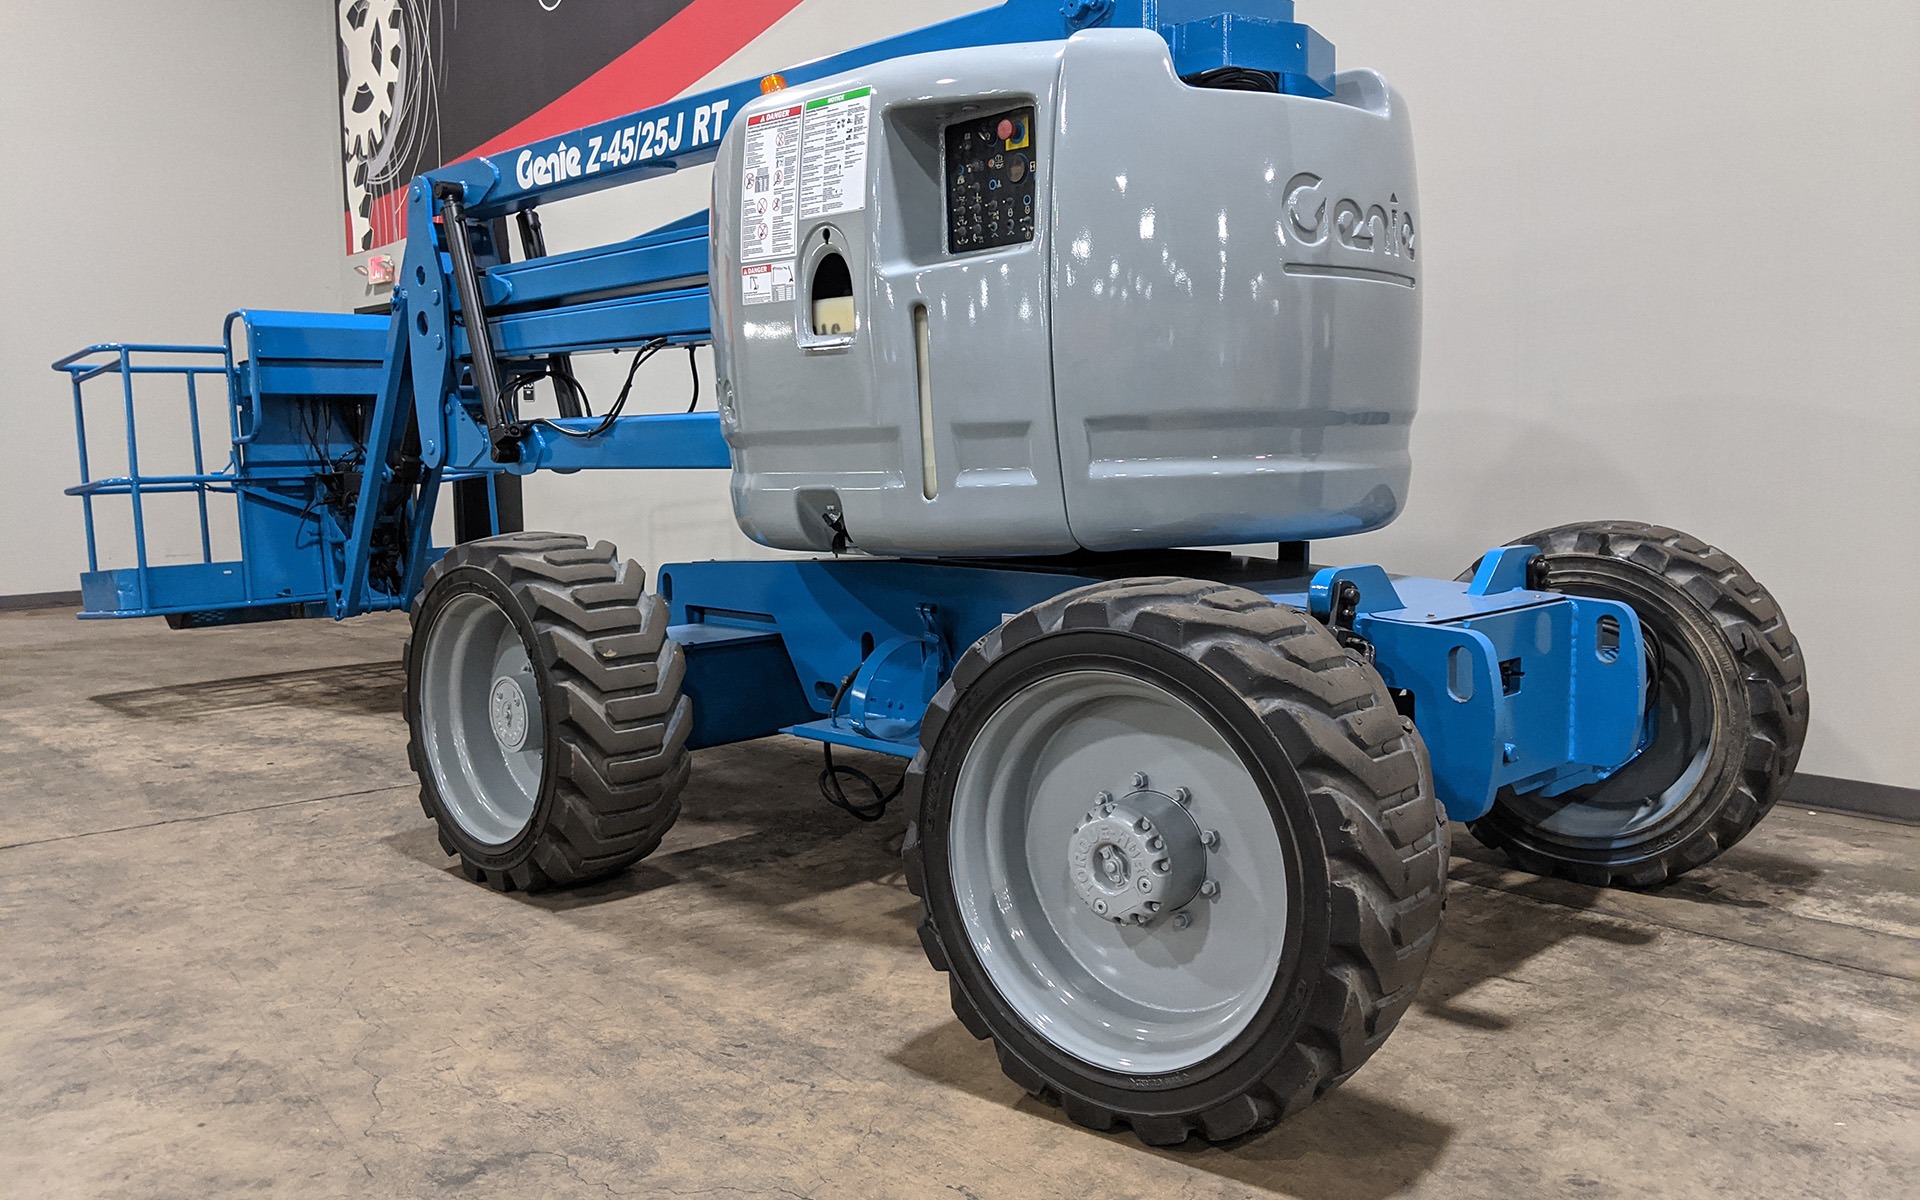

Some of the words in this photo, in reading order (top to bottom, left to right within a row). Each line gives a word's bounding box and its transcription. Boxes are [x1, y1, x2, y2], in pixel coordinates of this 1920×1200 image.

[766, 110, 790, 121] DANGER
[516, 141, 581, 189] Genie
[586, 112, 684, 174] Z-45/25J
[692, 99, 729, 147] RT
[1282, 172, 1415, 262] Genie
[748, 265, 768, 275] DANGER
